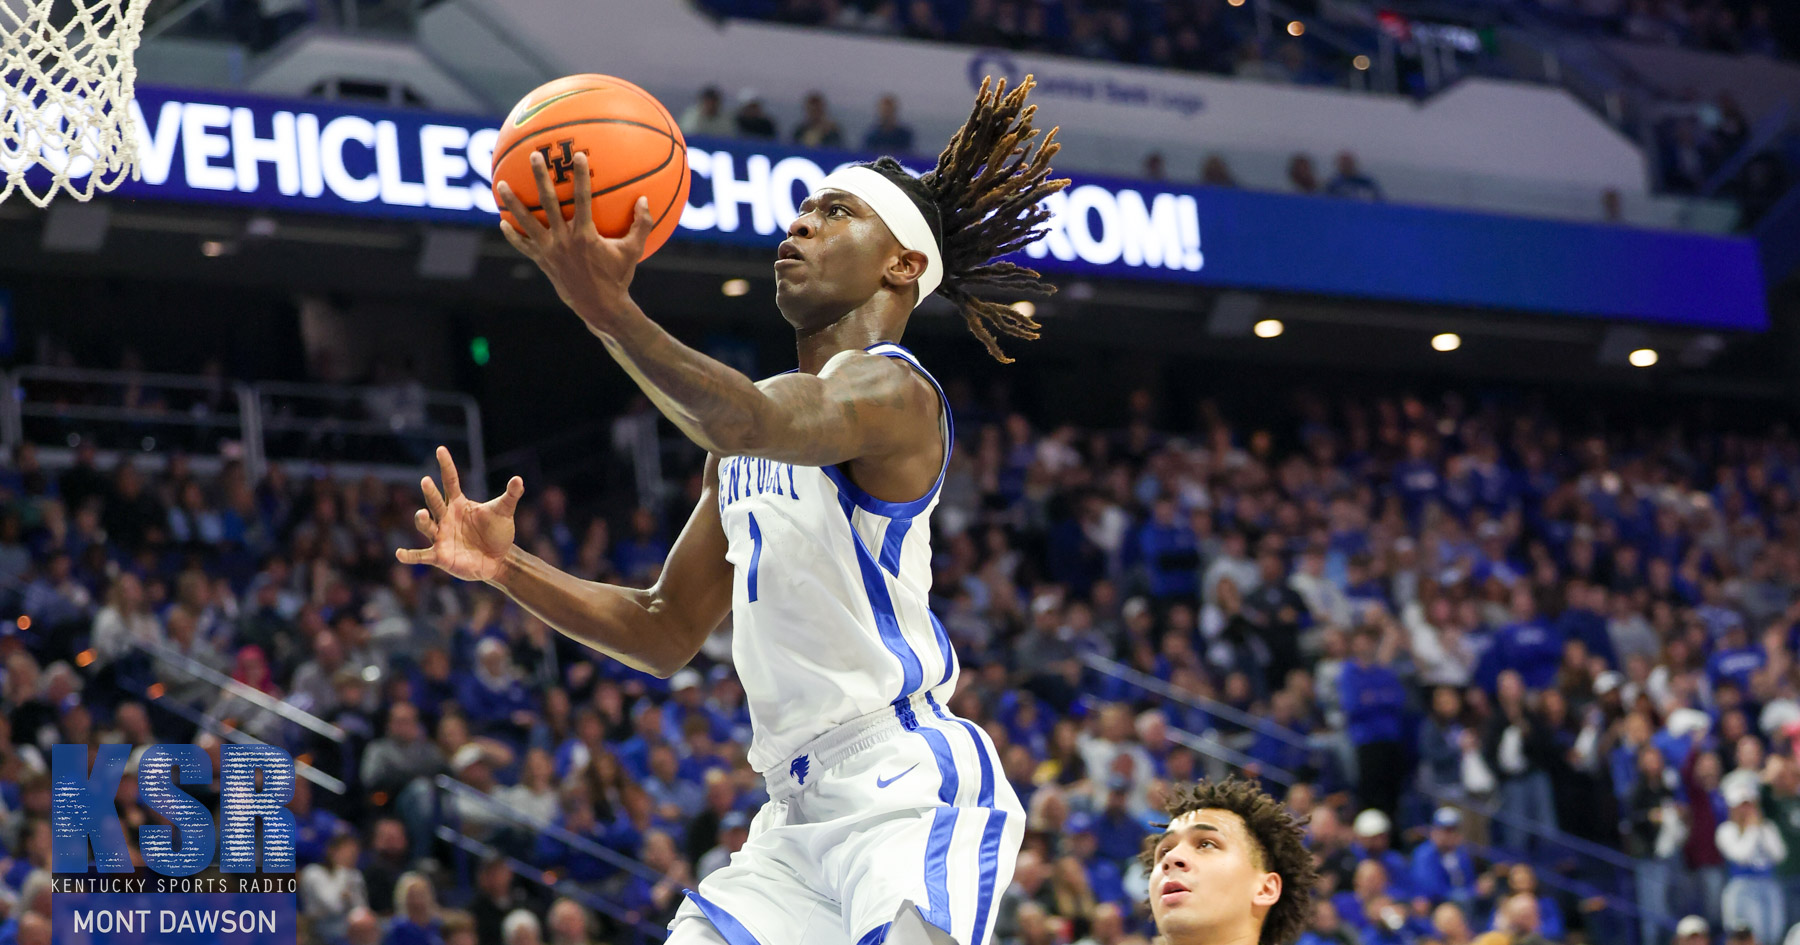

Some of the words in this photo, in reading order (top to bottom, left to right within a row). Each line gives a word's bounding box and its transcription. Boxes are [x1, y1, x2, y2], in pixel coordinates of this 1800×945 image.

[128, 98, 501, 214] VEHICLES
[990, 185, 1204, 271] ROM!
[748, 511, 763, 603] 1
